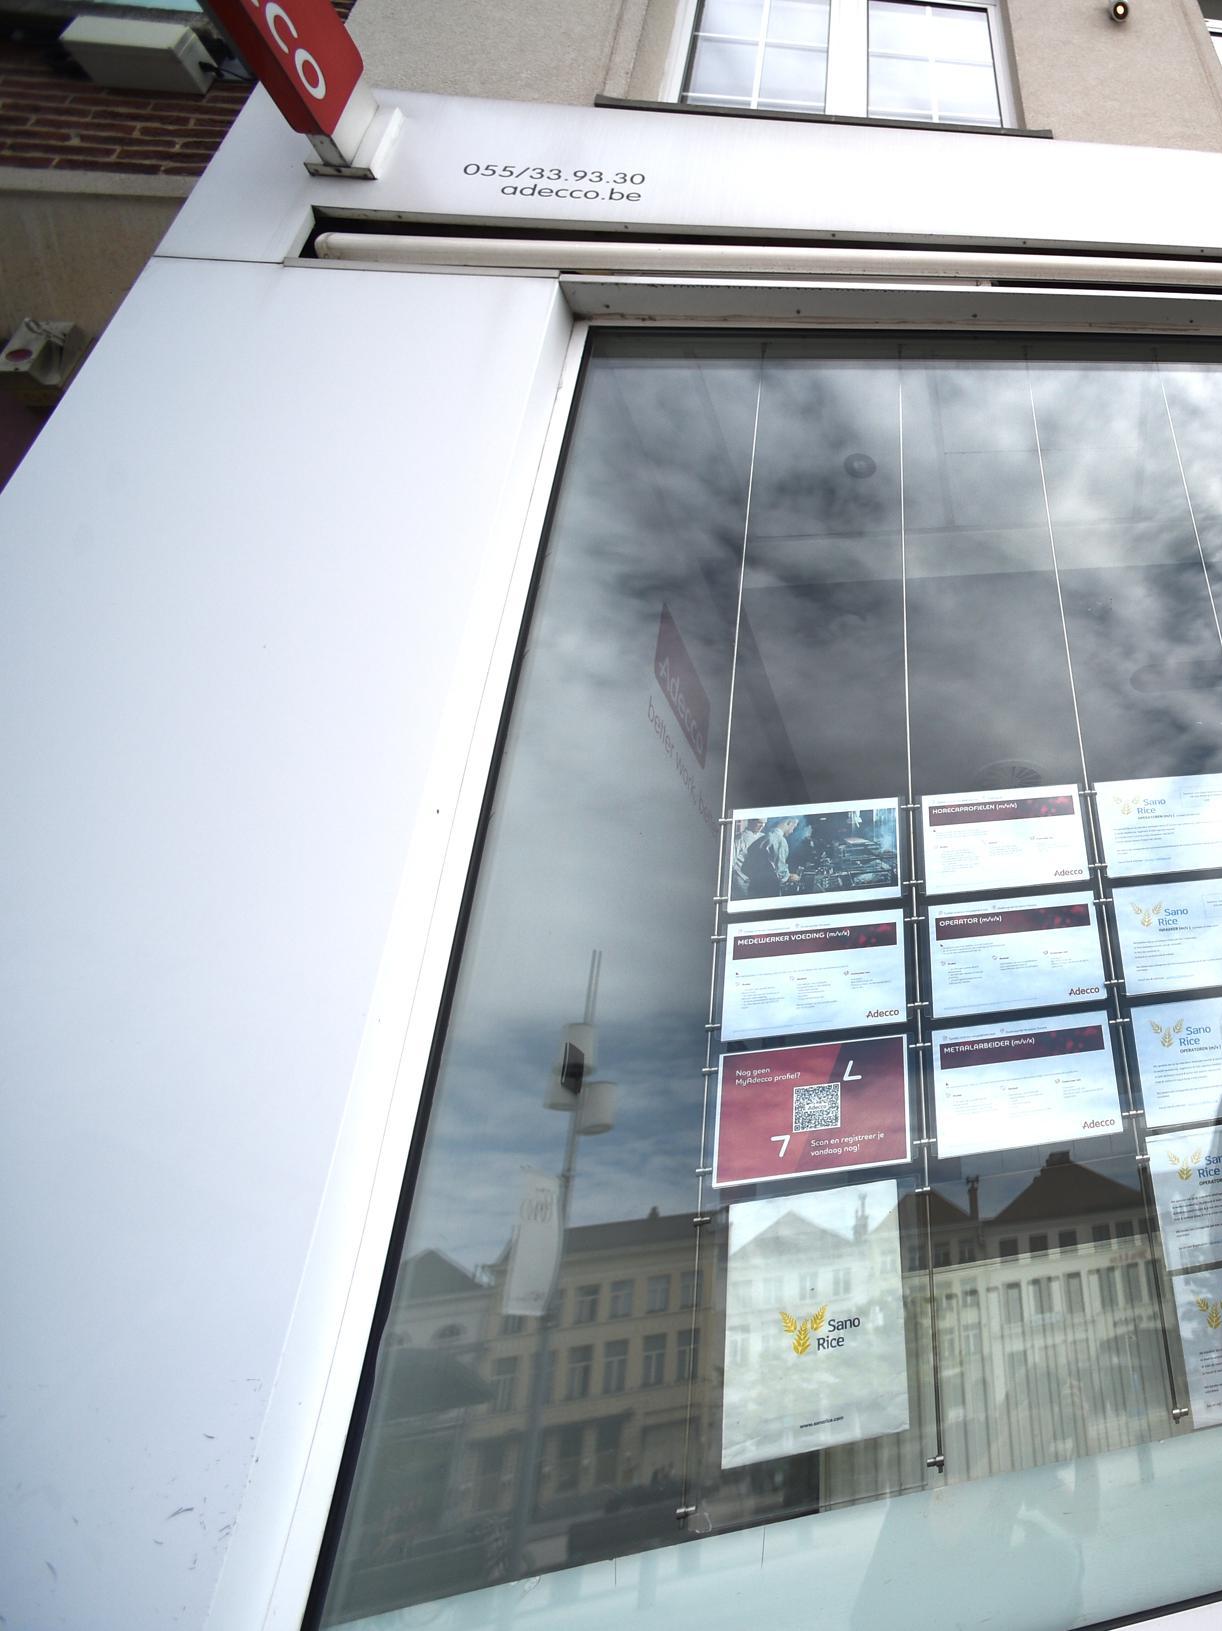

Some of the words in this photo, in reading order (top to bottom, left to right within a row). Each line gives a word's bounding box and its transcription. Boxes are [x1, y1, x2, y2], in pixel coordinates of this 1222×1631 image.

[251, 0, 327, 100] co
[463, 163, 646, 186] 055/33.93.30
[500, 182, 642, 203] adecco.be
[1143, 797, 1167, 807] Sano
[932, 803, 995, 815] HORECAPROFIELEN
[1137, 806, 1157, 815] Rice
[1054, 867, 1084, 877] Adecco
[1164, 907, 1189, 917] Sano
[939, 917, 979, 927] OPERATOR
[1158, 917, 1178, 927] Rice
[737, 935, 790, 946] MEDEWERKER
[791, 931, 825, 941] VOEDING
[1068, 985, 1100, 996] Adecco
[865, 1008, 900, 1019] Adecco
[1185, 1025, 1212, 1036] Sano
[944, 1039, 1010, 1054] METAALARBEIDER
[1011, 1037, 1035, 1047] (m/v/x)
[1179, 1036, 1201, 1047] Rice
[735, 1069, 751, 1077] Nog
[752, 1067, 771, 1077] geen
[735, 1075, 773, 1087] MyAdecco
[774, 1071, 801, 1084] profiel?
[1082, 1117, 1116, 1130] Adecco
[810, 1138, 829, 1147] Scan
[840, 1133, 877, 1145] registreer
[877, 1132, 885, 1141] je
[810, 1146, 842, 1156] vandaag
[843, 1143, 860, 1154] nog!
[1197, 1166, 1221, 1179] Rice
[827, 1315, 861, 1333] Sano
[816, 1335, 845, 1351] Rice
